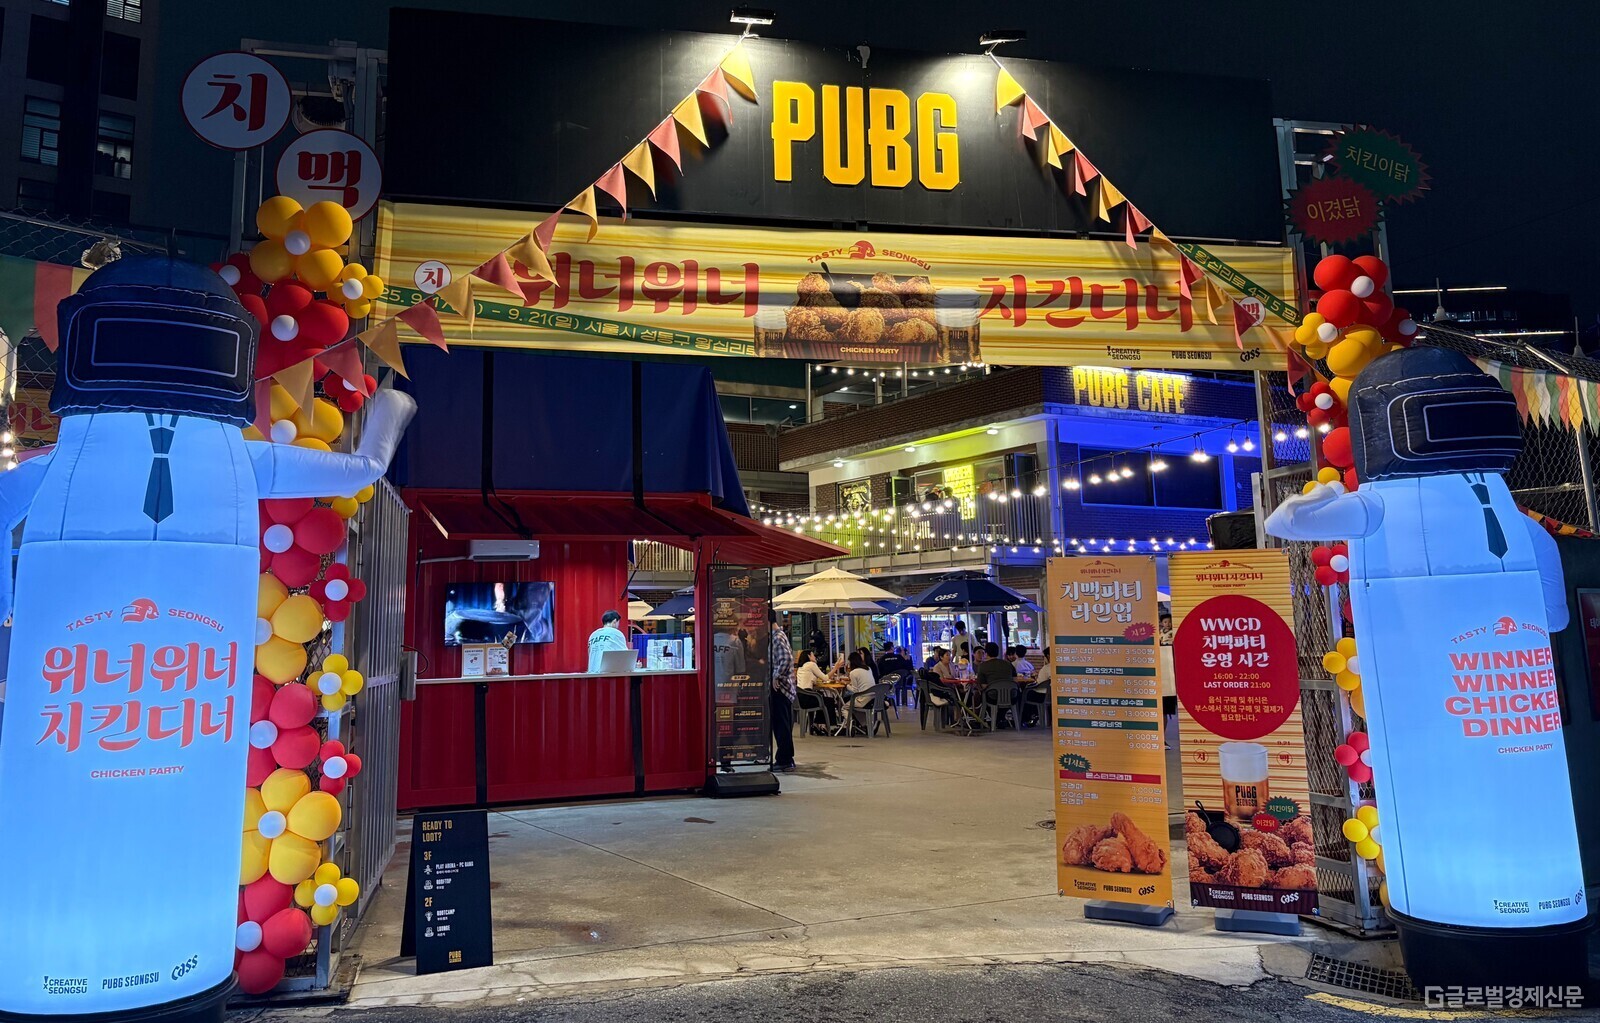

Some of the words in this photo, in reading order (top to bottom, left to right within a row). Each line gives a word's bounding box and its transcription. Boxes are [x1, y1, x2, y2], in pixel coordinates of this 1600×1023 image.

[201, 73, 268, 131] 치
[771, 80, 960, 190] PUBG
[1345, 145, 1411, 184] 치킨이닭
[297, 150, 361, 208] 맥
[1307, 195, 1361, 222] 이겼닭
[807, 248, 843, 264] TASTY
[882, 249, 931, 271] SEONGSU
[422, 267, 443, 288] 치
[512, 251, 761, 318] 위너위너
[978, 274, 1194, 333] 치킨디너
[1270, 300, 1282, 312] 5
[584, 320, 637, 339] 서울시
[640, 329, 691, 346] 성동구
[840, 346, 874, 354] CHICKEN
[876, 347, 899, 355] PARTY
[1172, 351, 1186, 359] PUBG
[1073, 367, 1129, 409] PUBG
[1136, 375, 1185, 414] CAFE
[1195, 573, 1229, 582] 위너위너
[1230, 572, 1263, 581] 치킨디너
[1060, 580, 1142, 601] 치맥파티
[66, 609, 113, 632] TASTY
[168, 608, 225, 632] SEONGSU
[1071, 602, 1133, 623] 라인업
[1200, 617, 1261, 631] WWCD
[1202, 634, 1266, 650] 치맥파티
[1450, 626, 1487, 644] TASTY
[1201, 652, 1233, 668] 운영
[1237, 652, 1270, 668] 시간
[1448, 646, 1553, 671] WINNER
[42, 641, 238, 695] 위너위너
[1203, 681, 1221, 689] LAST
[1222, 681, 1249, 689] ORDER
[1451, 668, 1556, 693] WINNER
[1208, 696, 1222, 704] 음식
[1223, 696, 1237, 704] 구매
[1238, 696, 1246, 704] 및
[1195, 704, 1222, 713] 부스에서
[1223, 705, 1237, 713] 직접
[1238, 705, 1253, 713] 구매
[1253, 705, 1261, 713] 및
[1262, 705, 1284, 713] 결제가
[35, 694, 235, 753] 치킨디너
[1221, 713, 1258, 722] 필요합니다.
[1462, 711, 1562, 737] DINNER
[1498, 745, 1534, 754] CHICKEN
[1535, 743, 1553, 752] PARTY
[90, 769, 146, 779] CHICKEN
[149, 765, 185, 776] PARTY
[1235, 785, 1257, 799] PUBG
[1236, 798, 1258, 807] SEONGSU
[1268, 804, 1294, 813] 치킨이닭
[422, 820, 443, 831] READY
[444, 819, 453, 829] TO
[422, 832, 442, 842] LOOT?
[423, 851, 432, 861] 3F
[424, 897, 433, 907] 2F
[49, 978, 88, 987] CREATIVE
[102, 977, 124, 990] PUBG
[125, 971, 160, 987] SEONGSU
[48, 986, 87, 994] SEONGSU
